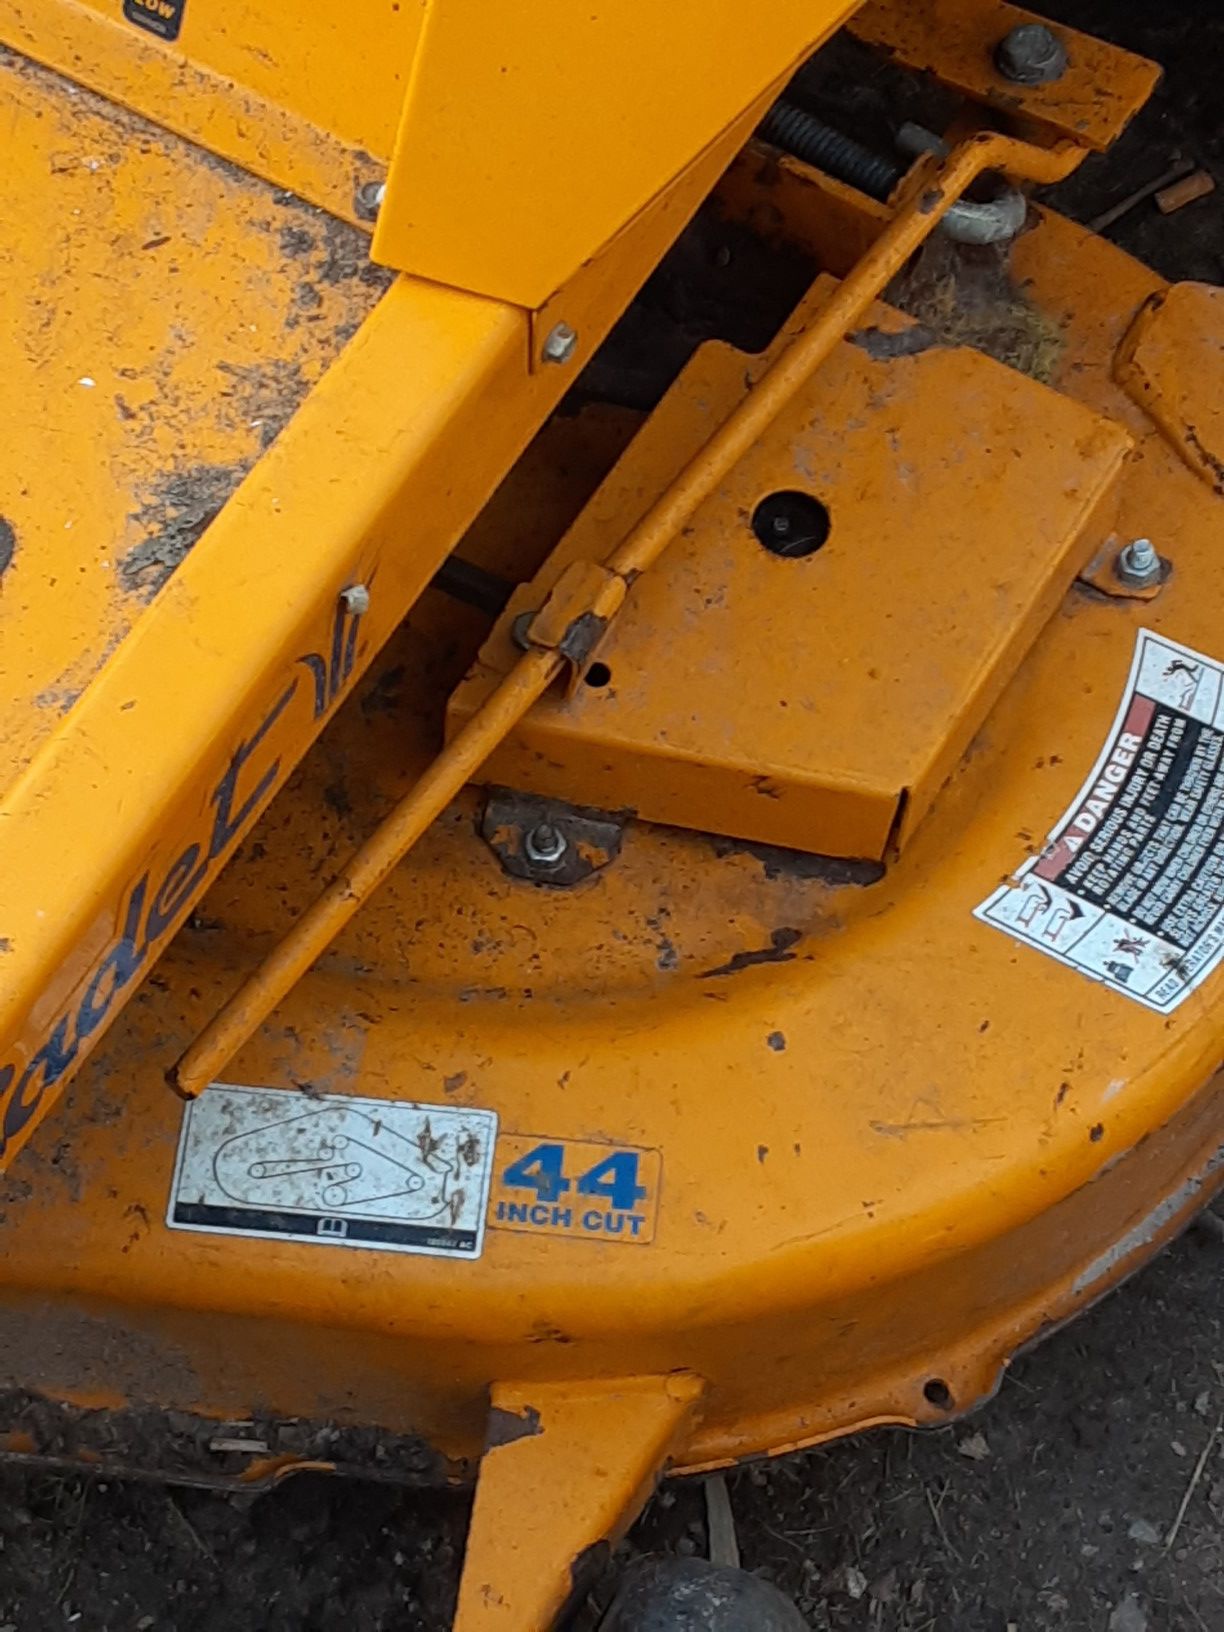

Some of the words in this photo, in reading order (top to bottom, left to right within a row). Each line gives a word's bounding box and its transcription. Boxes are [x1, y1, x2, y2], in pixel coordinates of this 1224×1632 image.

[1145, 714, 1171, 750] DEATH
[1138, 750, 1157, 768] OR
[1072, 732, 1142, 833] DANGER
[1082, 862, 1106, 889] KEEP
[1102, 828, 1133, 864] HANDS
[1125, 805, 1146, 830] AND
[1138, 779, 1162, 806] FEET
[1152, 748, 1175, 780] AWAY
[1165, 716, 1186, 748] FROM
[1118, 766, 1148, 808] INJURY
[1089, 806, 1128, 853] SERIOUS
[1066, 848, 1092, 884] AVOID
[1091, 846, 1135, 895] ROTATING
[503, 1144, 646, 1210] 44
[496, 1201, 571, 1227] INCH
[582, 1209, 645, 1235] CUT
